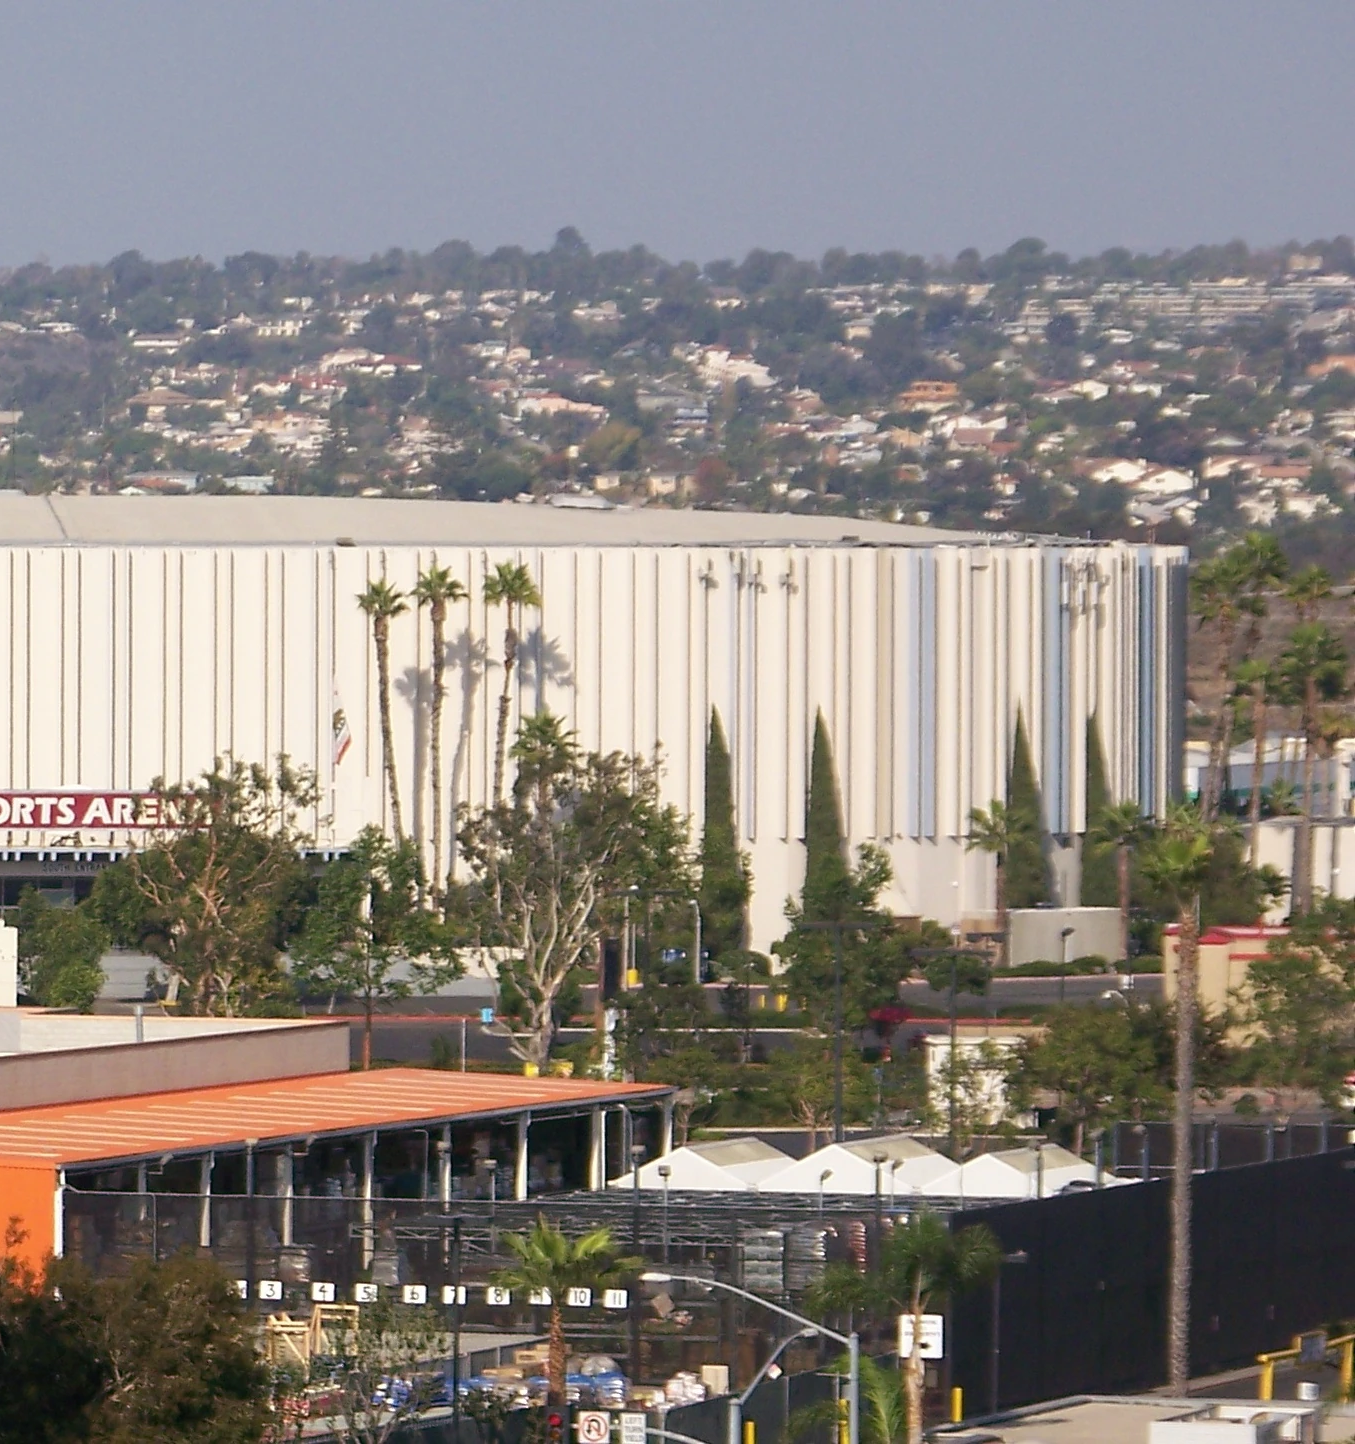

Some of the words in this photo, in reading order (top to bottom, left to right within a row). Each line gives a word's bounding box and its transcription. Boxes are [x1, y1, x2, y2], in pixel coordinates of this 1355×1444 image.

[265, 1284, 275, 1297] 3
[318, 1284, 329, 1299] 4
[409, 1287, 419, 1301] 6
[494, 1289, 503, 1303] 8
[573, 1290, 587, 1304] 10
[612, 1291, 622, 1306] 11
